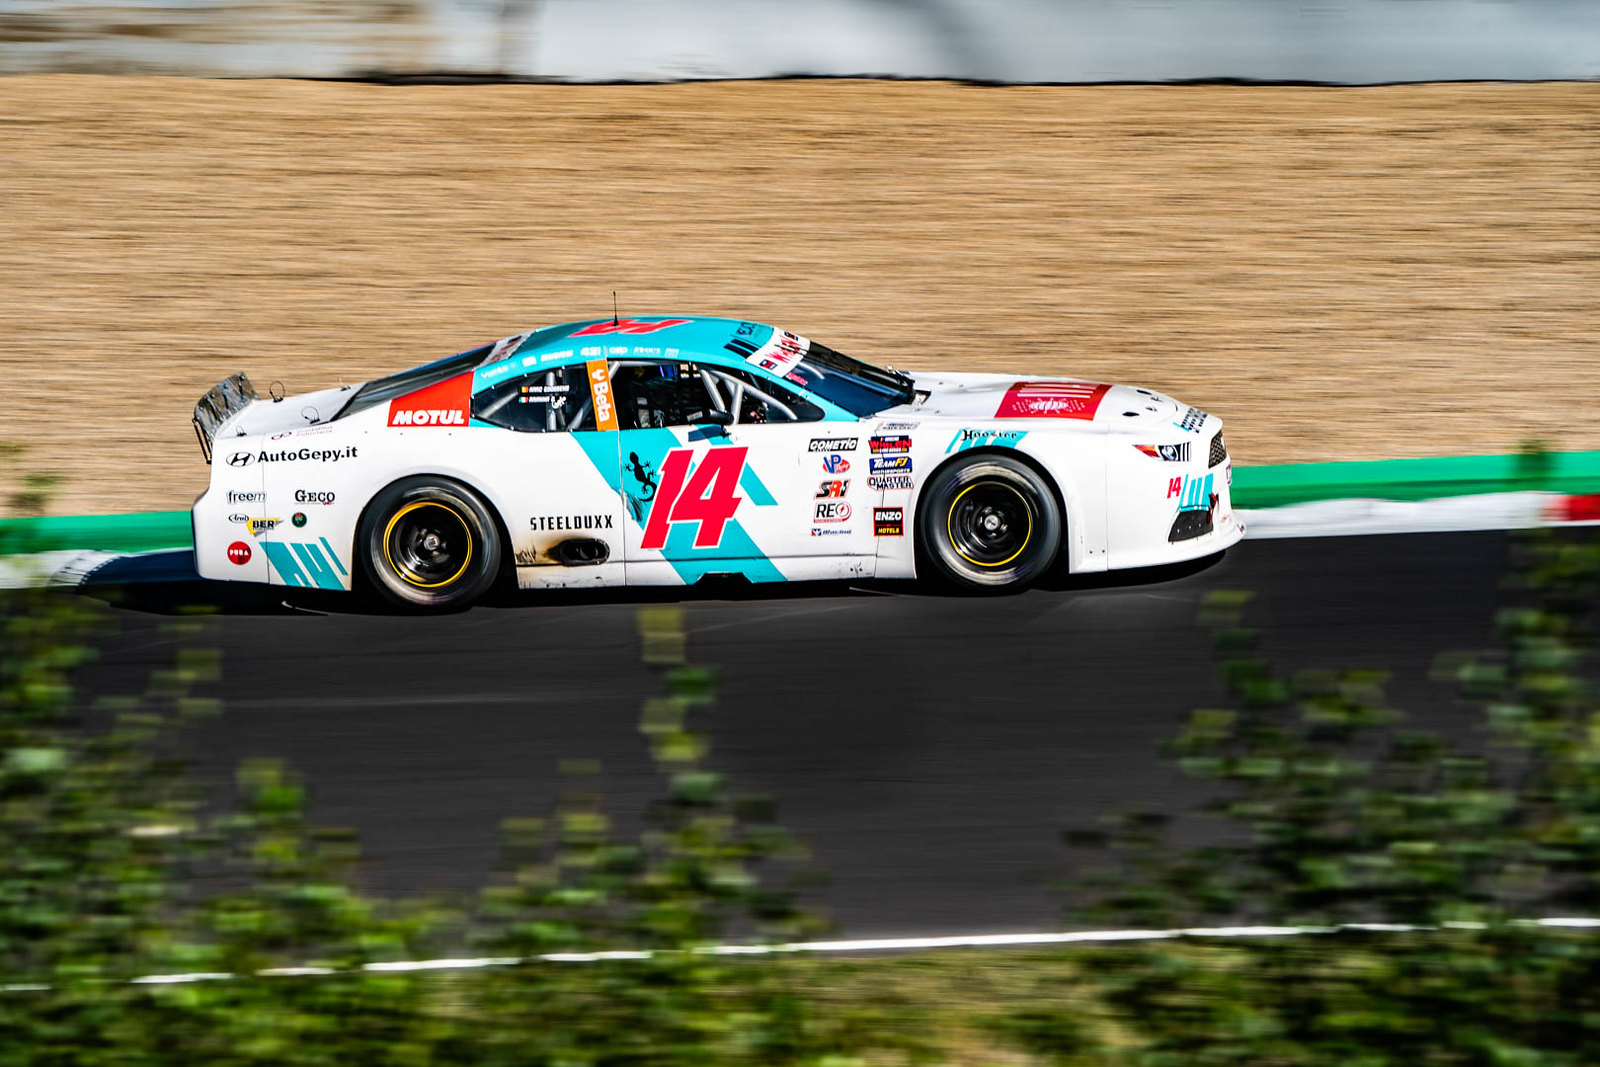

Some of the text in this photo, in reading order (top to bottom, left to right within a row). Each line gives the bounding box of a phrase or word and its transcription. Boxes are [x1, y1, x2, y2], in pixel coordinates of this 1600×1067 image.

[593, 381, 612, 422] Beta
[392, 410, 465, 425] MOTUL
[257, 446, 358, 463] AutoGepy.it
[823, 454, 842, 474] VP
[1167, 476, 1182, 499] 14
[640, 446, 749, 550] 14
[875, 511, 902, 521] ENZO
